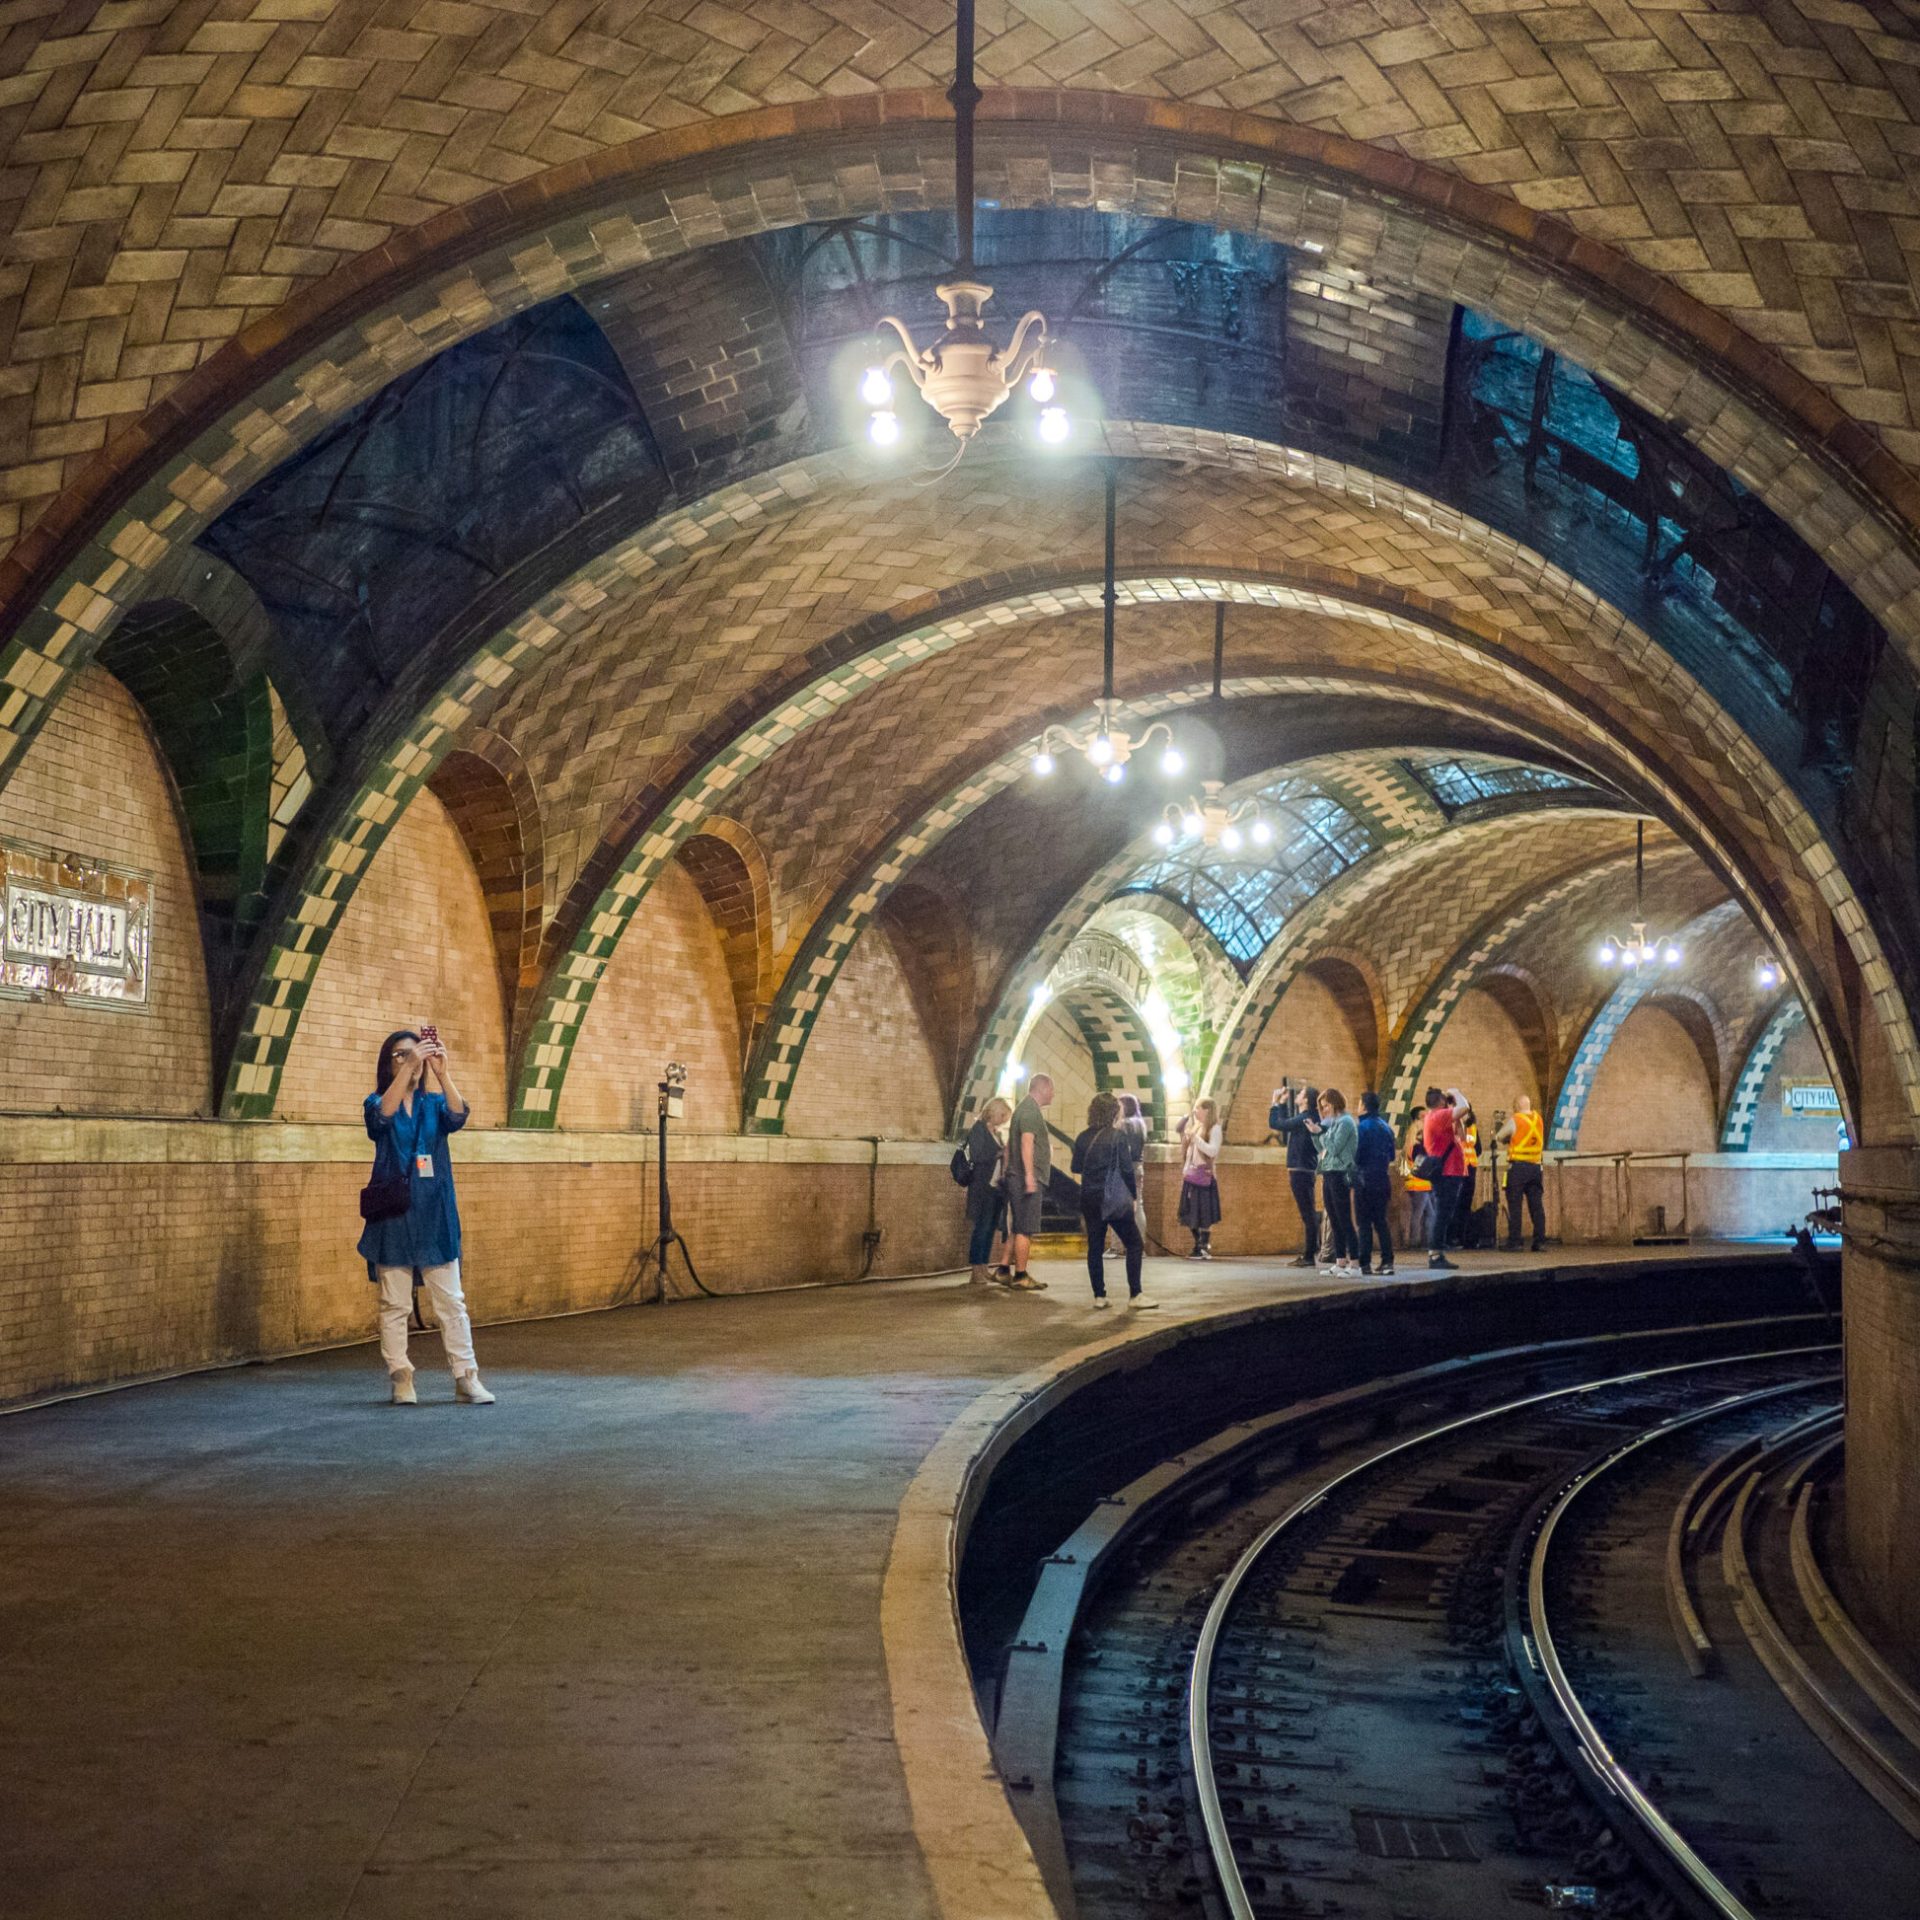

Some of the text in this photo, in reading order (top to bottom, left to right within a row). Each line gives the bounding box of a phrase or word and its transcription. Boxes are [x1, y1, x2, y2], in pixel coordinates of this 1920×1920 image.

[12, 897, 122, 959] CITY HALL
[1056, 946, 1092, 978] CITY
[1794, 1091, 1838, 1105] CITY HAL
